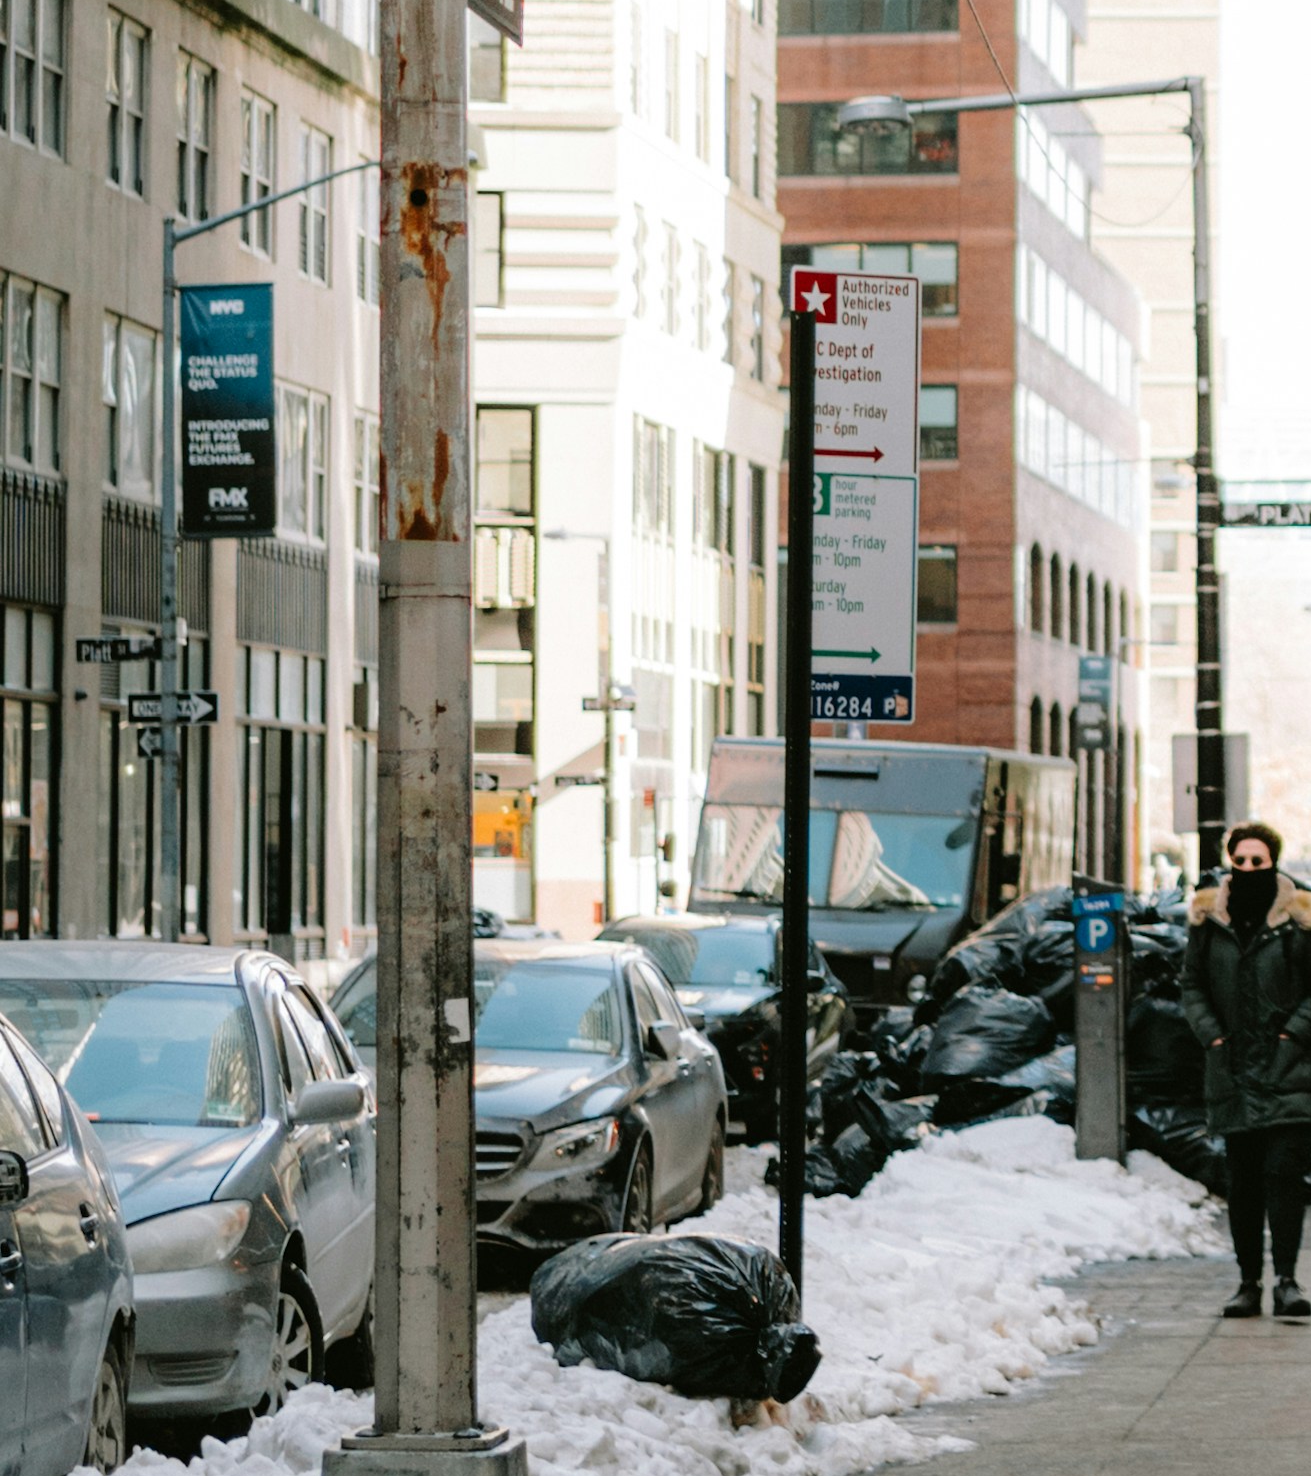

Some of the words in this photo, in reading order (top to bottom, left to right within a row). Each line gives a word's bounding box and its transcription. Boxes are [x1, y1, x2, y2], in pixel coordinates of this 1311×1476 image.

[842, 281, 910, 297] Authorized
[842, 297, 892, 312] Vehicles
[841, 313, 868, 330] Only
[829, 342, 858, 361] Dept
[861, 344, 875, 359] of
[188, 354, 259, 368] CHALLENGE
[189, 367, 212, 379] THE
[213, 366, 258, 378] STATUS
[853, 404, 888, 422] Friday
[833, 421, 858, 438] 6pm
[835, 479, 857, 490] hour
[209, 487, 249, 508] FMX
[835, 494, 876, 505] metered
[835, 507, 871, 520] parking
[852, 535, 887, 553] Friday
[833, 552, 861, 568] 10pm
[836, 598, 864, 614] 10pm
[176, 702, 200, 714] AY
[1089, 918, 1109, 949] P
